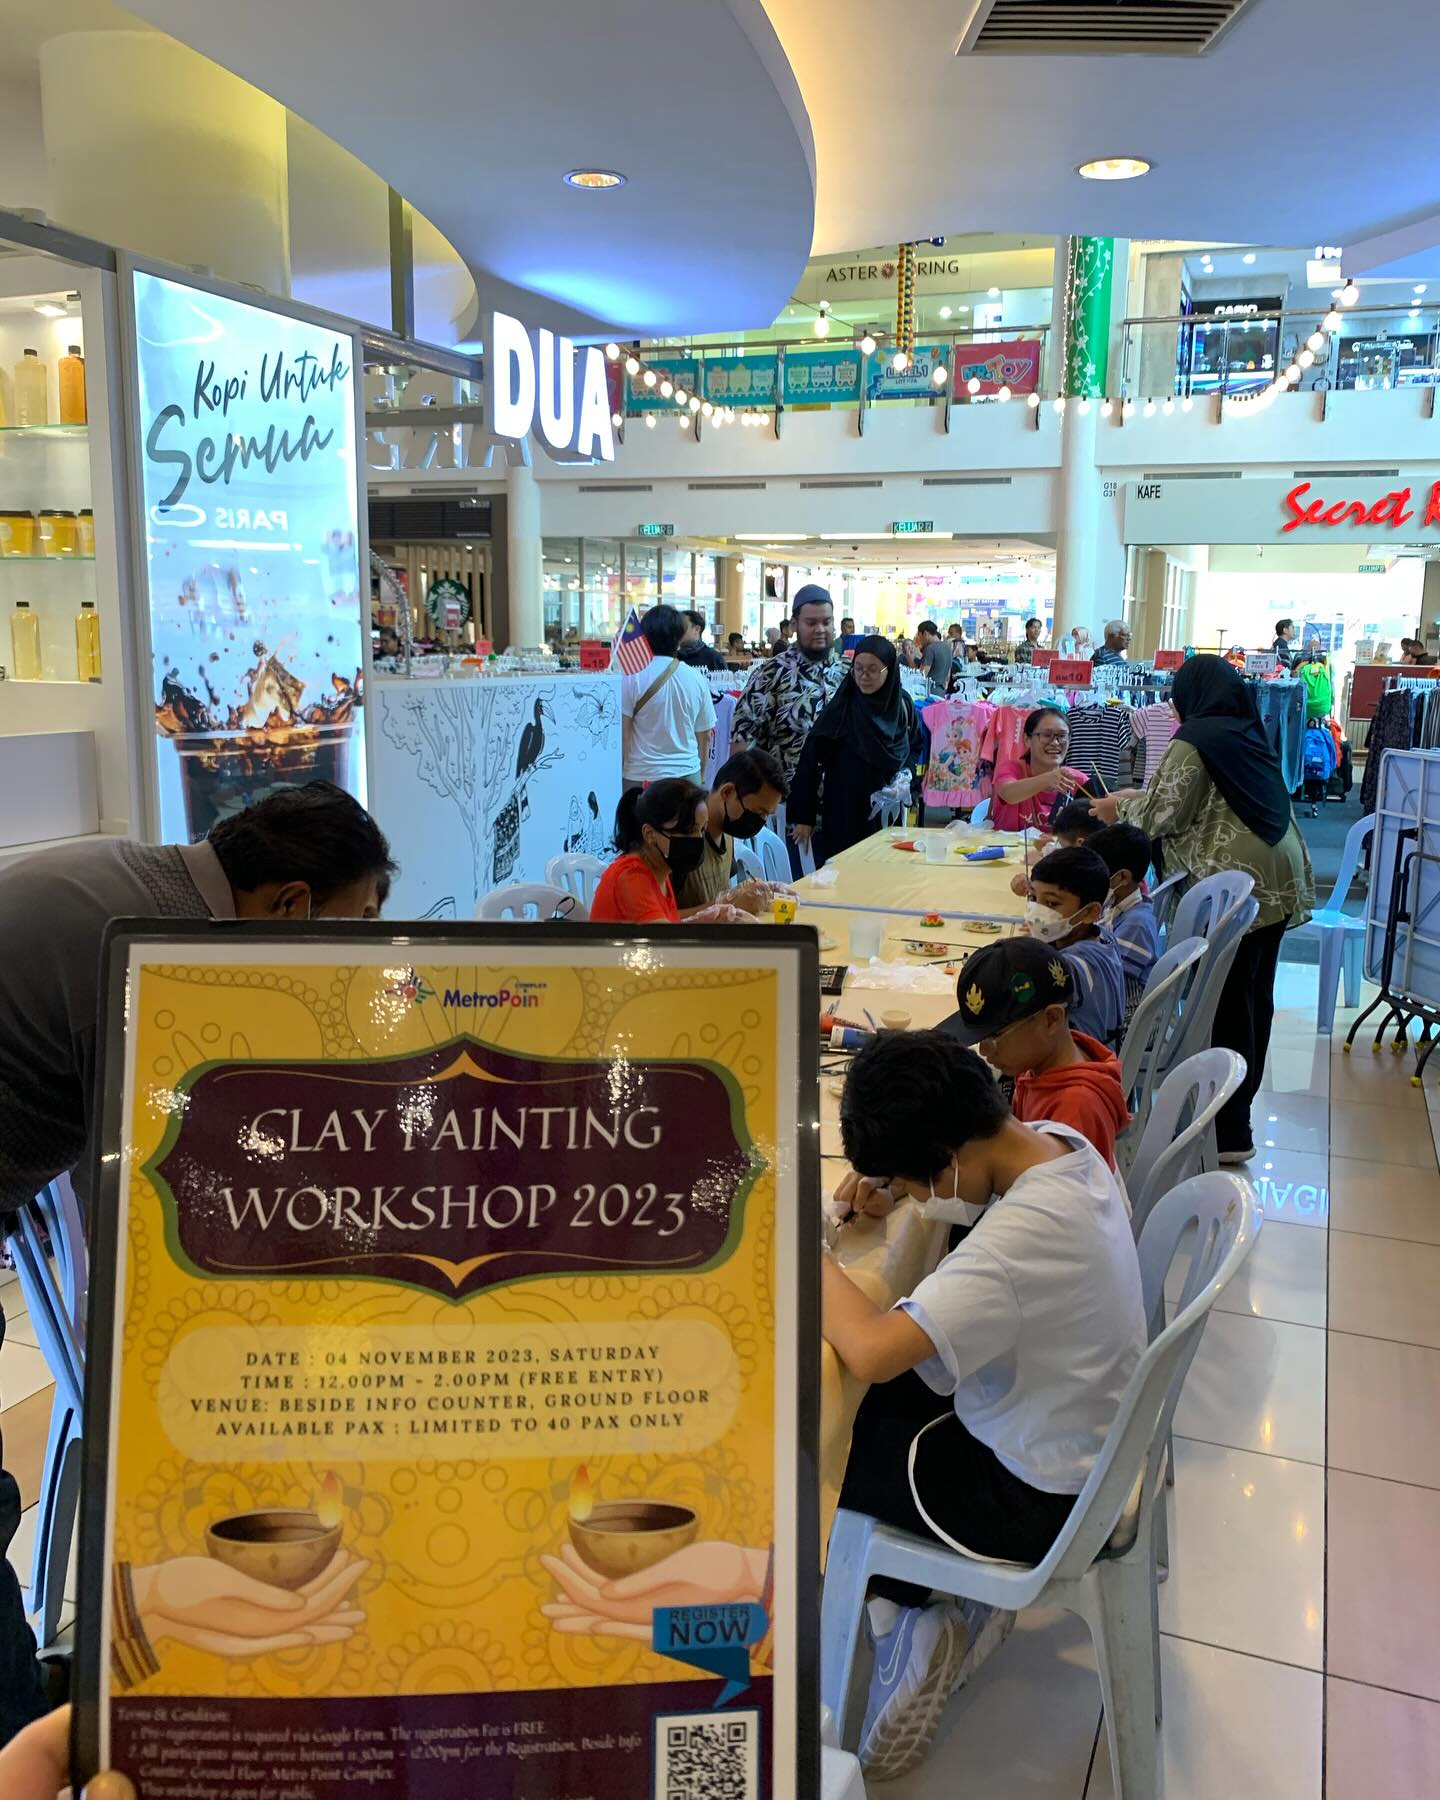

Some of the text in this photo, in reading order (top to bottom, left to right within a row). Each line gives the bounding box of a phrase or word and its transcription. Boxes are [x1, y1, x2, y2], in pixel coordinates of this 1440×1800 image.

[826, 259, 959, 283] ASTER RING
[194, 343, 350, 419] Kopi Untuk
[493, 311, 616, 462] DUA
[146, 404, 334, 513] Semua
[1137, 484, 1161, 499] KAFE
[1282, 481, 1415, 532] Secret
[893, 521, 924, 533] KELUAR
[443, 988, 542, 1009] MetroPoin
[248, 1105, 662, 1152] CLAY PAINTING
[219, 1183, 686, 1236] WORKSHOP 2023
[246, 1351, 301, 1366] DATE
[325, 1352, 348, 1366] 04
[359, 1350, 476, 1366] NOVEMBER
[486, 1349, 541, 1364] 2023,
[550, 1345, 660, 1362] SATURDAY
[240, 1375, 295, 1389] TIME
[319, 1374, 405, 1389] 12.00PM
[434, 1372, 510, 1388] 2.00PM
[519, 1370, 579, 1388] (FREE
[589, 1368, 664, 1385] ENTRY)
[190, 1389, 710, 1413] VENUE: BESIDE INFO COUNTER, GROUND FLOOR
[216, 1421, 334, 1436] AVAILABLE
[345, 1420, 385, 1435] PAX
[409, 1418, 501, 1434] LIMITED
[511, 1417, 538, 1432] TO
[547, 1416, 571, 1431] 40
[581, 1415, 620, 1430] PAX
[629, 1413, 685, 1429] ONLY
[670, 1607, 750, 1622] REGISTER
[669, 1618, 750, 1647] NOW
